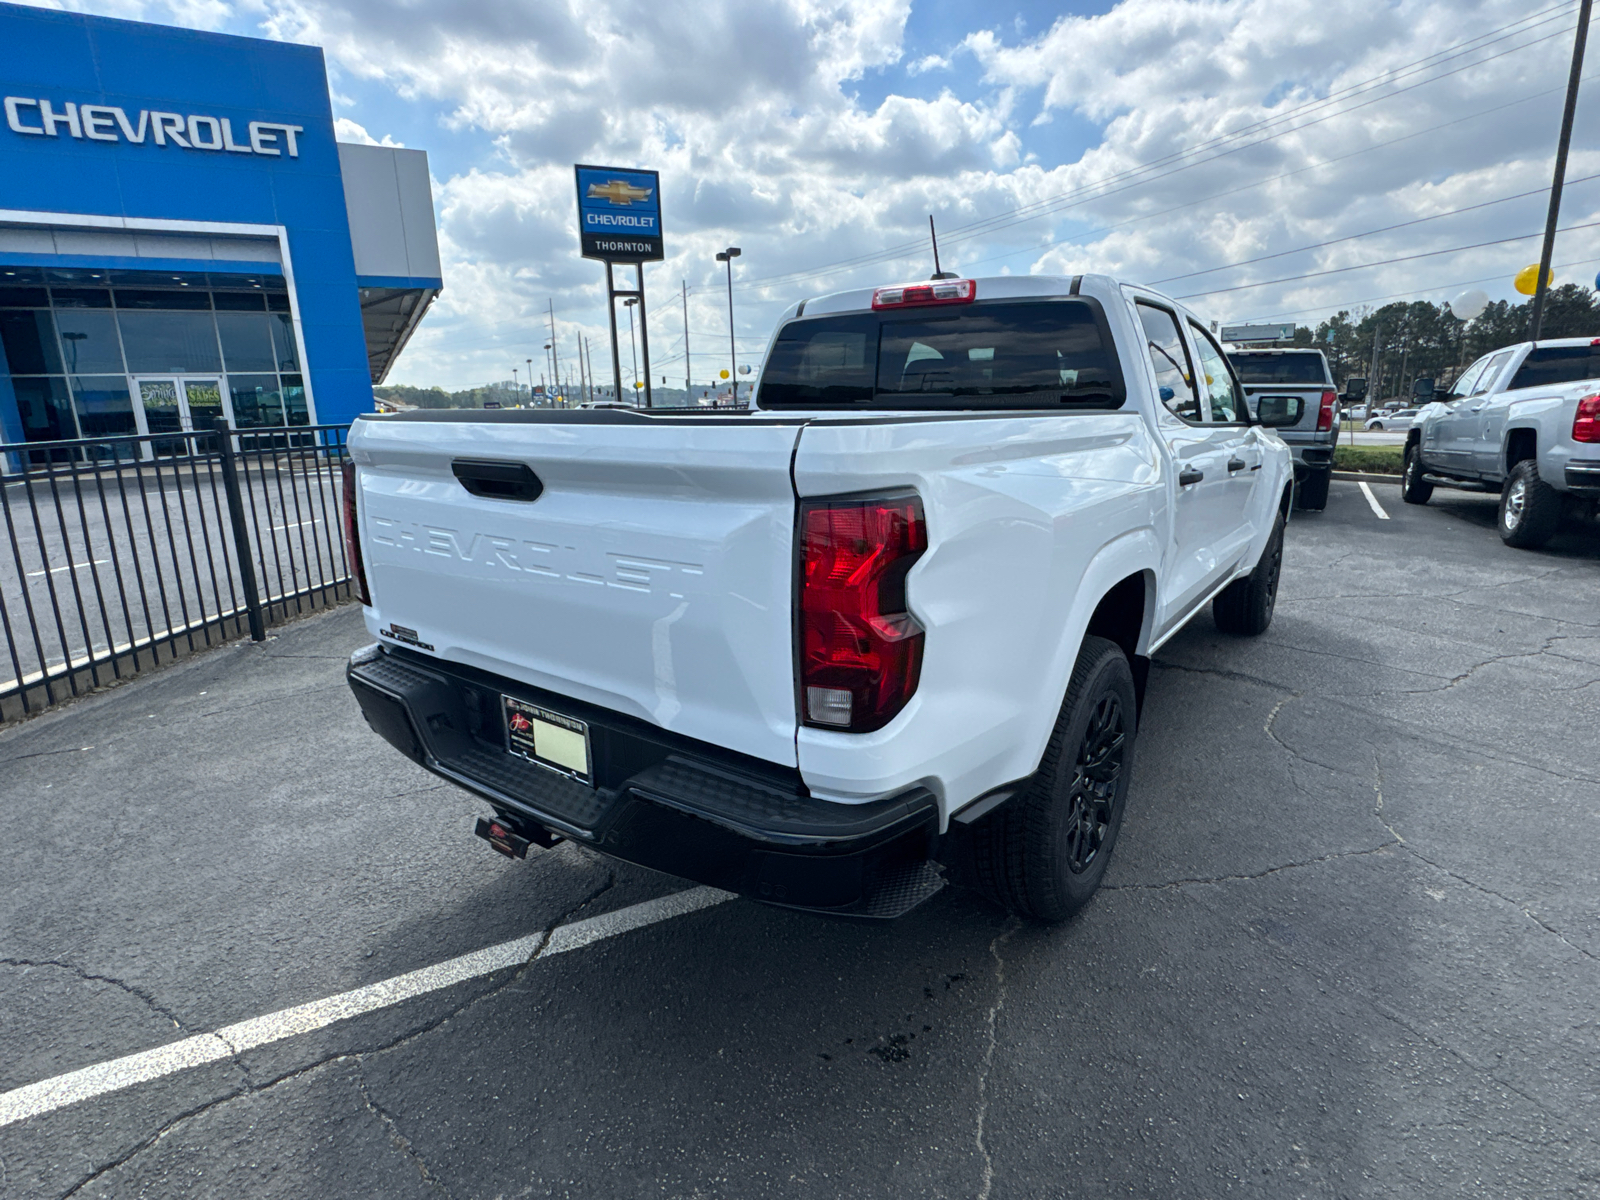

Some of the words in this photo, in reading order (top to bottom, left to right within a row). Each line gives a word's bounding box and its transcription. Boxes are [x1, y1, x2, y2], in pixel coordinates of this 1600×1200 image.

[4, 96, 304, 157] CHEVROLET
[587, 213, 654, 227] CHEVROLET
[595, 240, 652, 252] THORNTON
[371, 515, 704, 599] CHEVROLET
